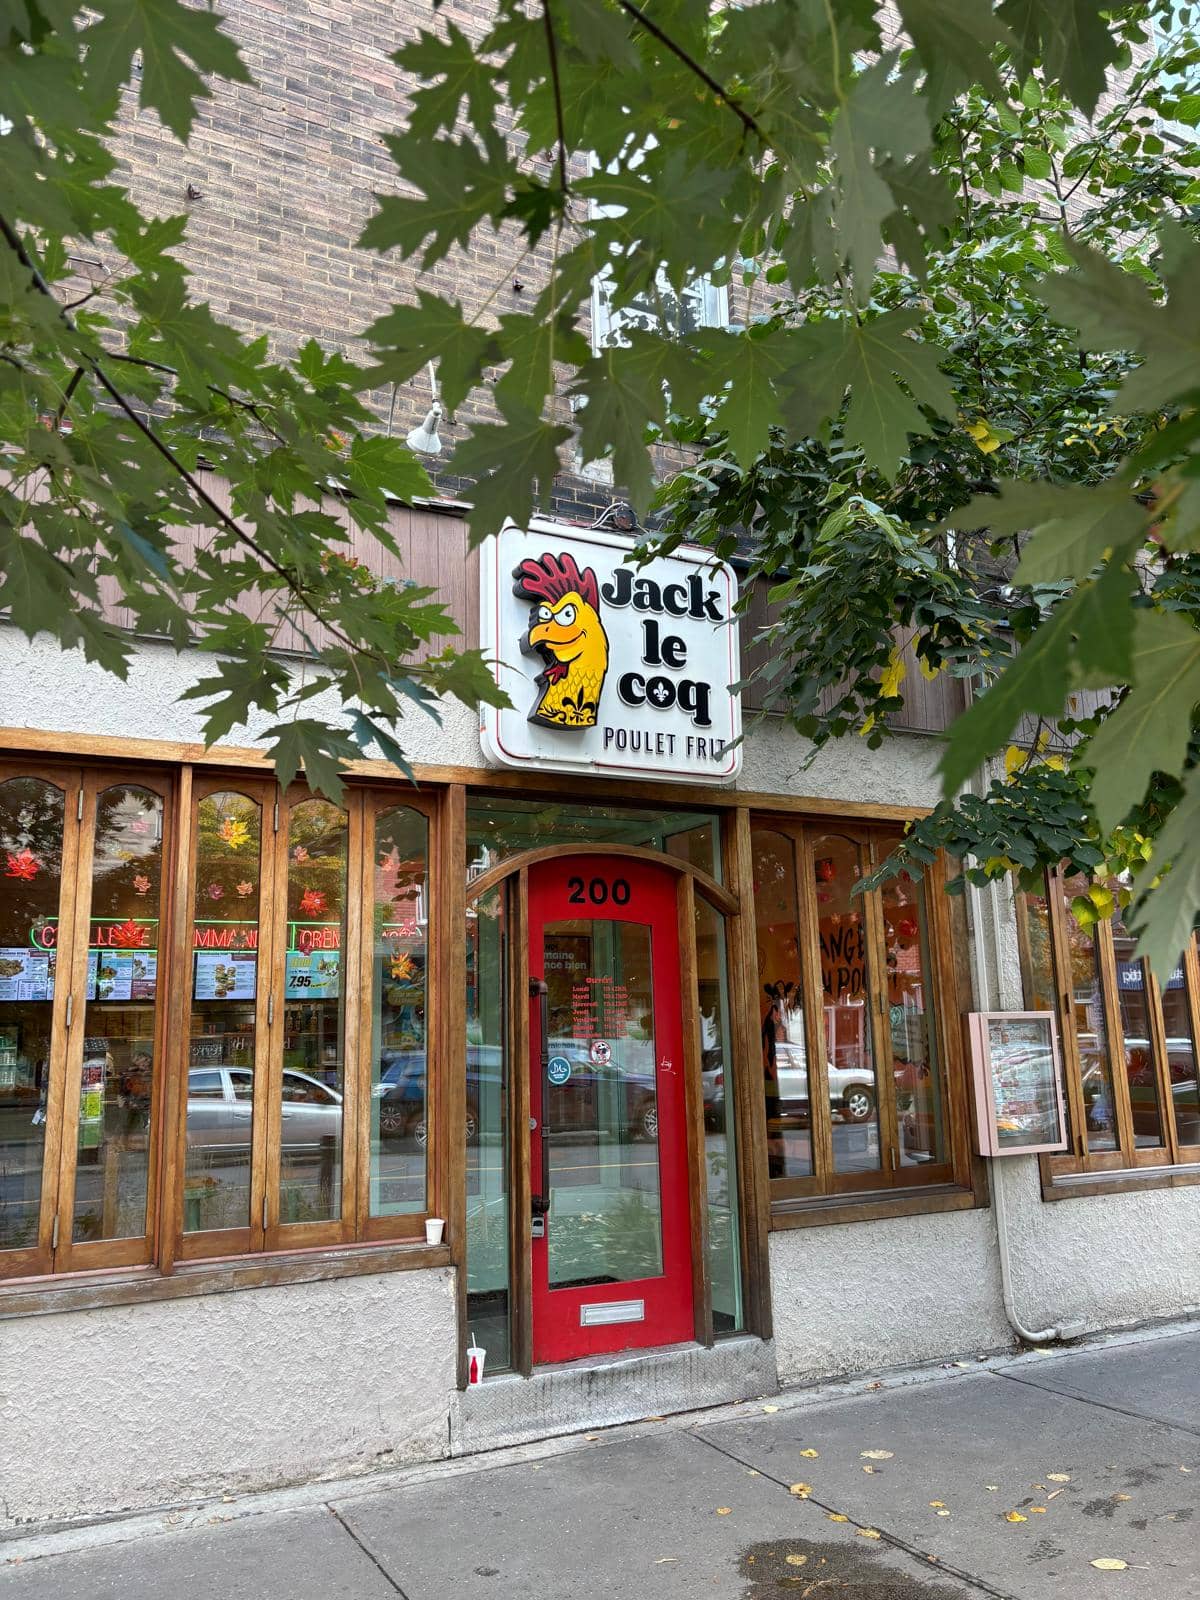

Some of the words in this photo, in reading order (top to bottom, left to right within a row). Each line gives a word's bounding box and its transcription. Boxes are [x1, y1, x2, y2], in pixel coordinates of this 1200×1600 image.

[601, 568, 724, 621] Jack
[642, 619, 688, 669] le
[618, 672, 712, 727] coq
[603, 727, 677, 756] POULET
[686, 735, 726, 759] FRIT
[567, 877, 631, 905] 200
